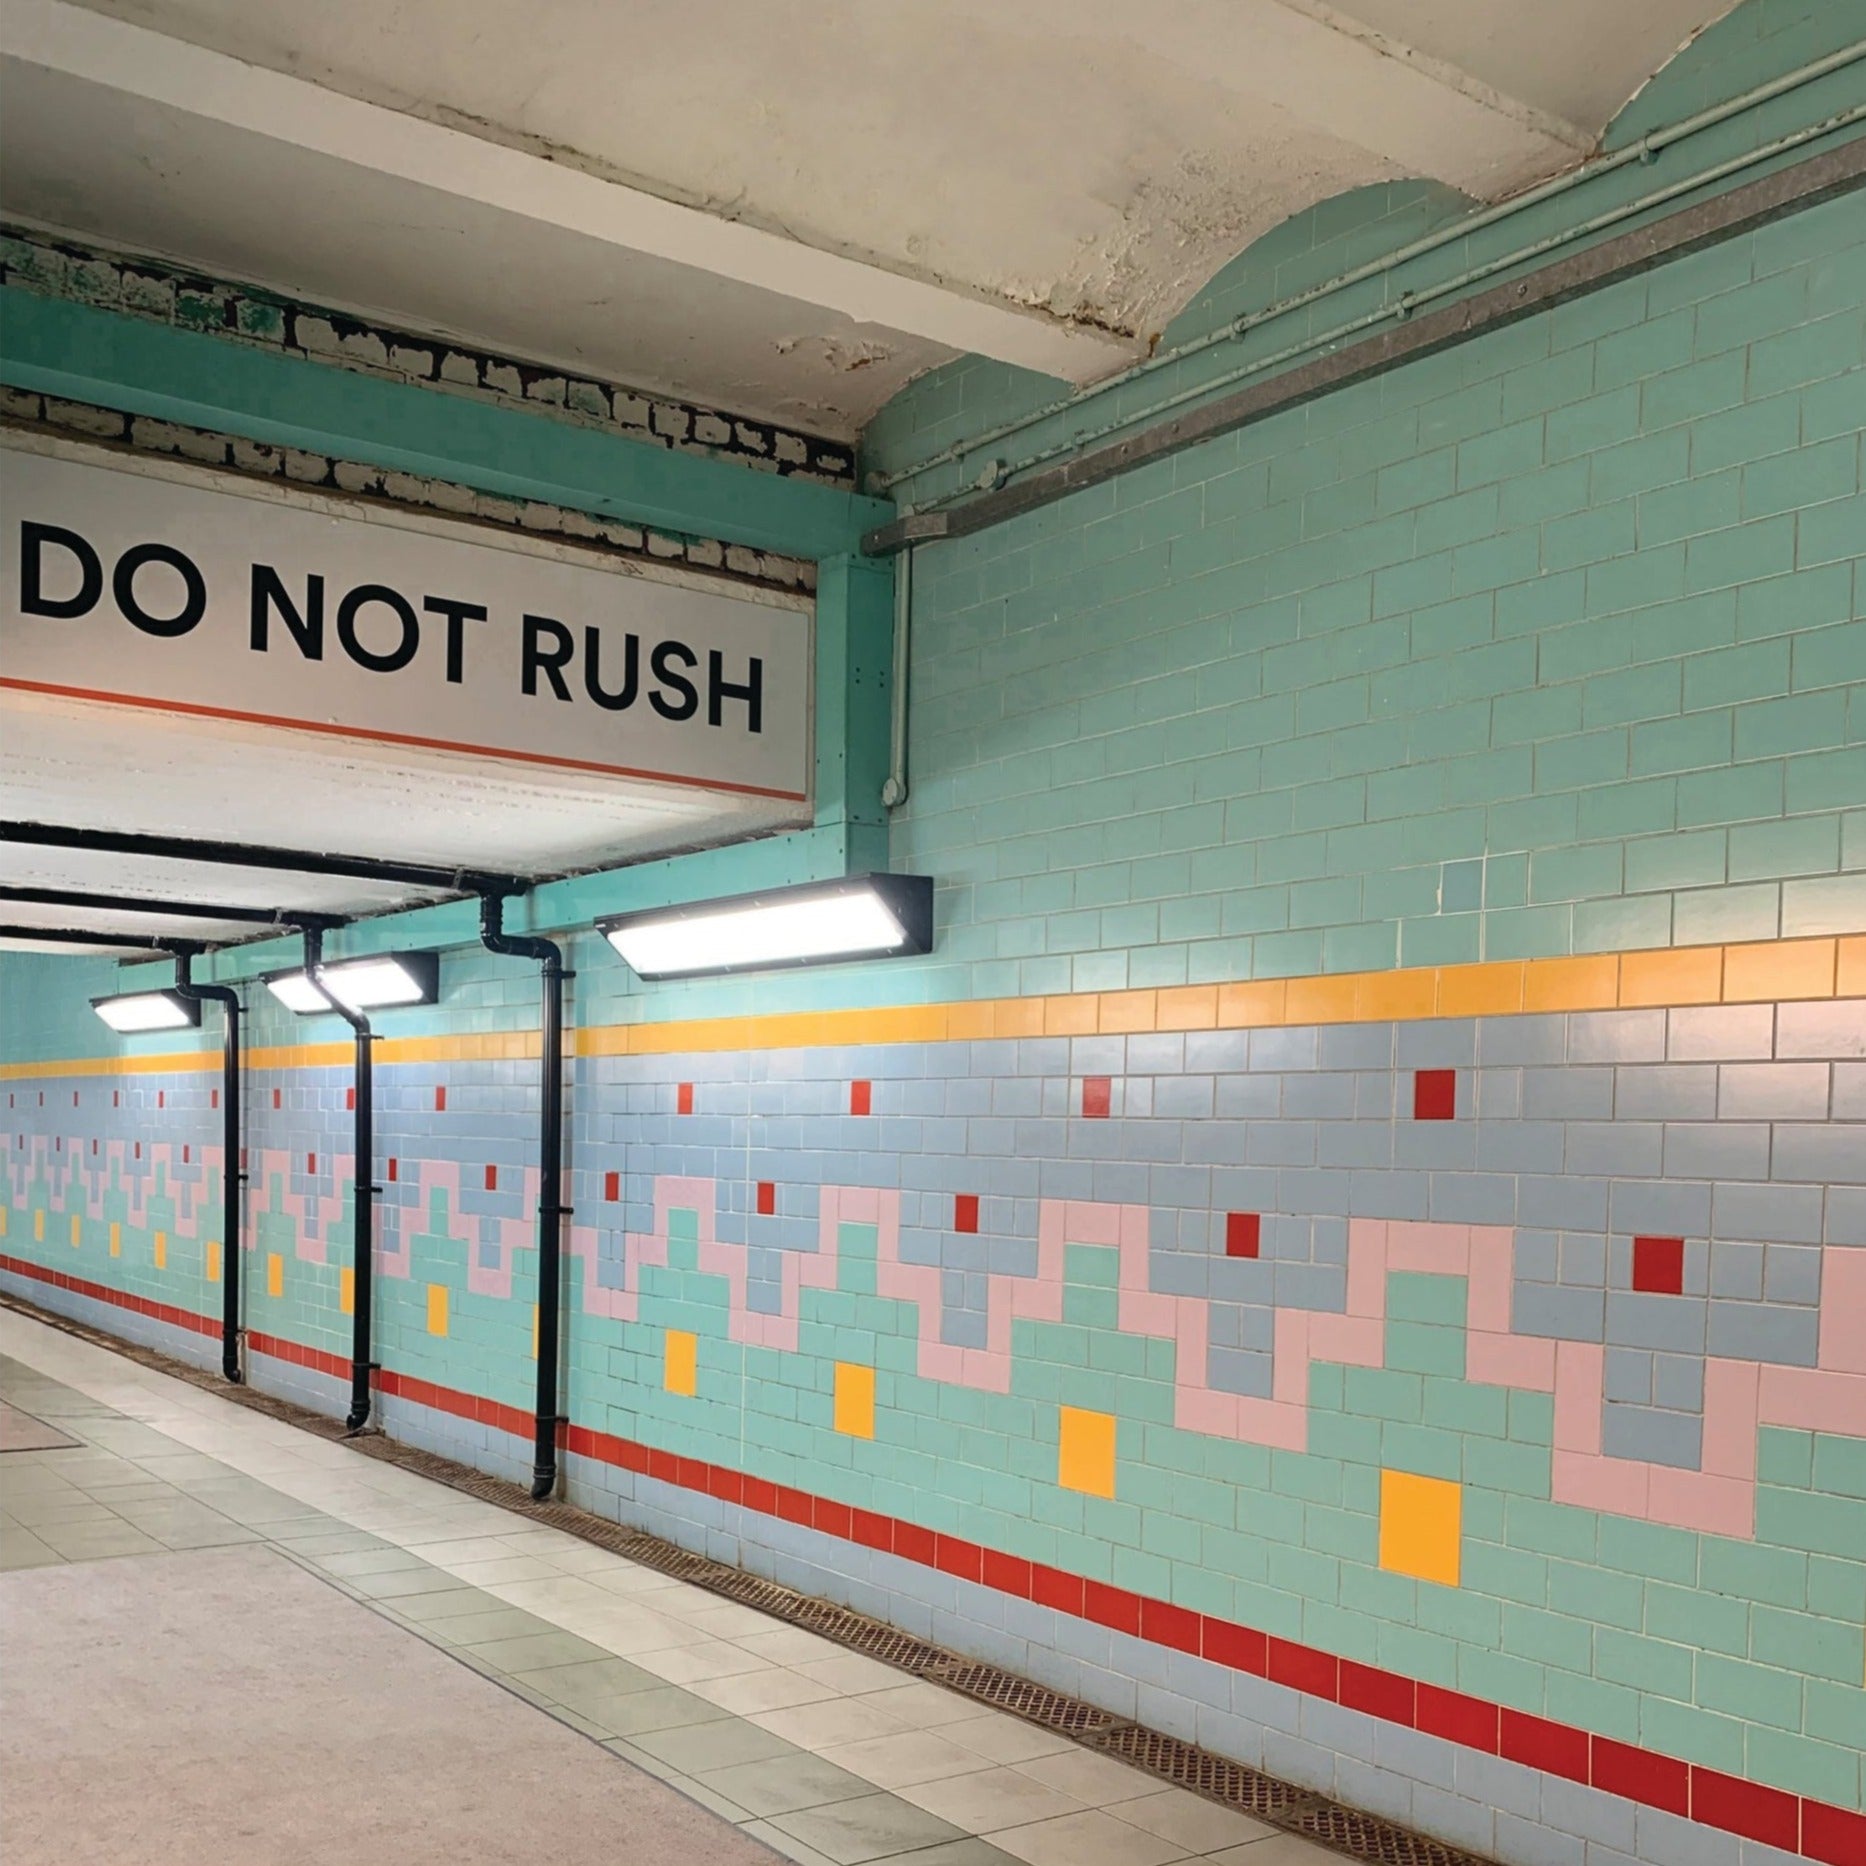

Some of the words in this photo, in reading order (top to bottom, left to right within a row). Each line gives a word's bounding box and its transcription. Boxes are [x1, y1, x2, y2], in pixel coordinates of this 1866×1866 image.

[20, 519, 207, 638] DO
[250, 563, 488, 684] NOT
[521, 613, 763, 734] RUSH
